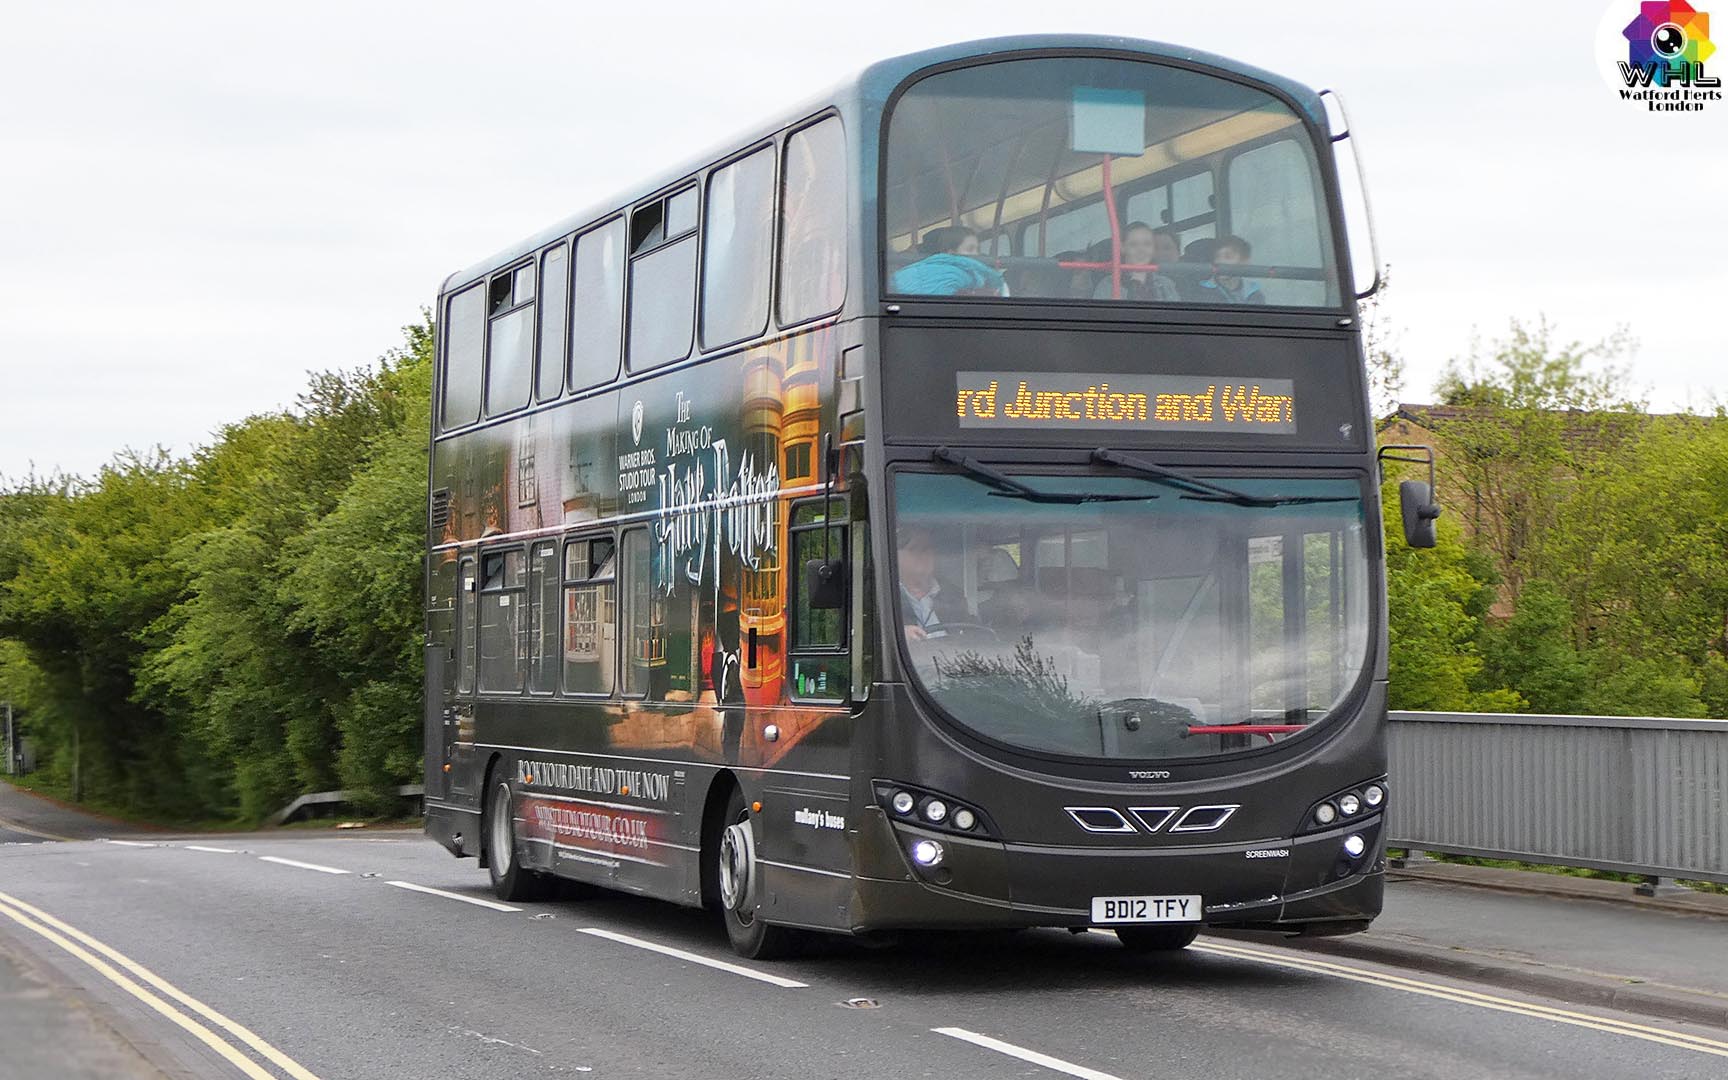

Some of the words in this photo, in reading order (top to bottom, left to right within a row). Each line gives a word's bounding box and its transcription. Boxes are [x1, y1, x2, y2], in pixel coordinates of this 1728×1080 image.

[957, 381, 998, 417] rd
[1004, 381, 1147, 420] Junction
[1155, 385, 1215, 421] and
[619, 451, 641, 470] WARNER
[641, 448, 656, 466] BROS.
[619, 470, 639, 492] STUDIO
[640, 467, 656, 487] TOUR
[628, 490, 647, 504] LONDON
[518, 759, 543, 785] BOOK
[542, 763, 568, 788] YOUR
[567, 765, 593, 792] DATE
[593, 767, 615, 794] AND
[615, 769, 642, 798] TIME
[642, 772, 670, 801] NOW
[1129, 771, 1170, 779] VOLVO
[825, 811, 845, 830] buses
[1245, 850, 1289, 859] SCREENWASH
[1104, 900, 1147, 919] BD12
[1153, 899, 1189, 918] TFY
